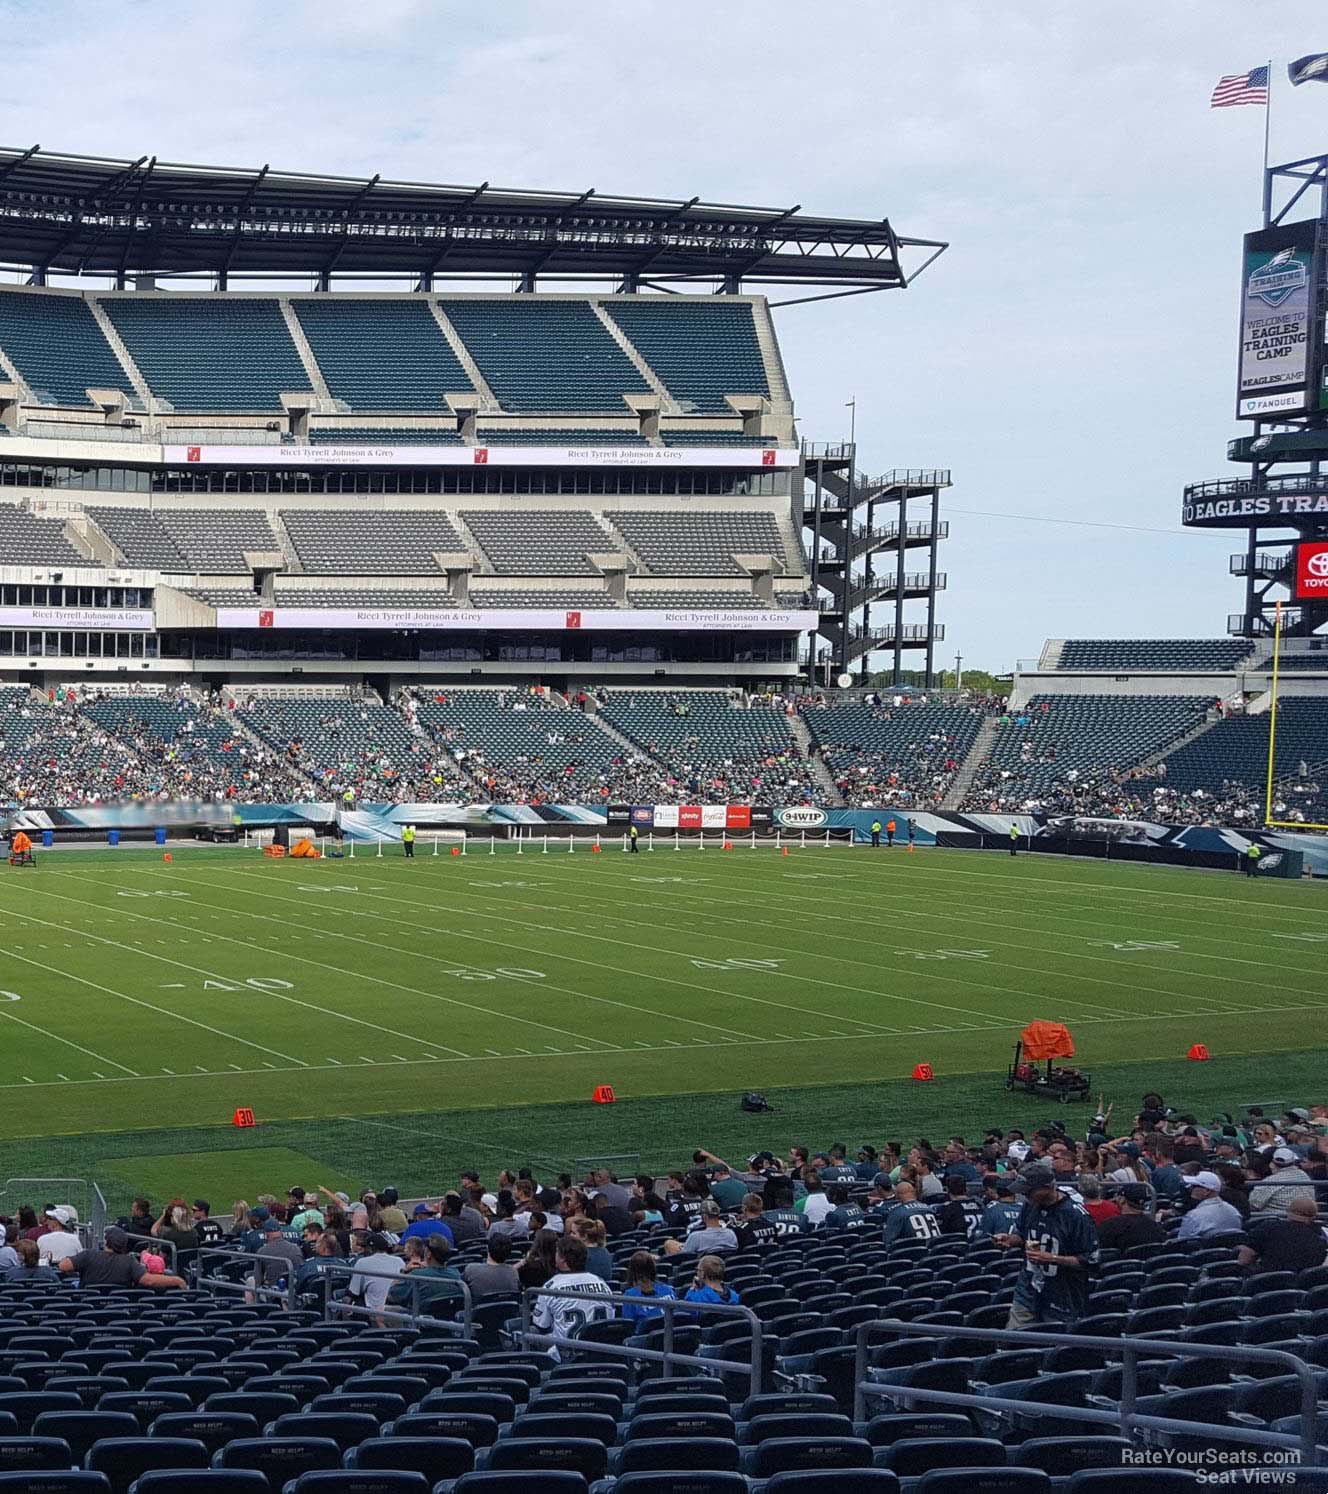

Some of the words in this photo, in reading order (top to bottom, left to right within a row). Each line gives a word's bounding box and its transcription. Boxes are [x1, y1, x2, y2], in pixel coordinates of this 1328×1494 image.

[1247, 315, 1292, 329] WELCOME
[1294, 311, 1305, 322] TO
[1252, 322, 1299, 339] EAGLES
[1244, 332, 1306, 351] TRAINING
[1256, 346, 1292, 360] CAMP
[1257, 397, 1296, 408] FANDUEL
[303, 449, 329, 458] Tyrrell
[331, 449, 366, 457] Johnson
[375, 449, 394, 458] Grey
[568, 450, 588, 458] Ricci
[591, 450, 617, 460] Tyrrell
[619, 450, 654, 458] Johnson
[663, 451, 683, 459] Grey
[1195, 498, 1270, 520] EAGLES
[1276, 495, 1328, 514] TRA
[32, 610, 53, 619] Ricci
[54, 611, 81, 621] Tyrrell
[83, 611, 116, 620] Johnson
[125, 613, 144, 622] Grey
[357, 612, 379, 620] Ricci
[382, 613, 411, 622] Tyrrell
[414, 613, 450, 621] Johnson
[461, 613, 482, 622] Grey
[665, 613, 688, 621] Ricci
[690, 613, 719, 623] Tyrrell
[721, 614, 759, 622] Johnson
[769, 614, 791, 623] Grey
[785, 812, 821, 821] 94WIP
[440, 967, 547, 982] 50
[202, 977, 294, 992] 40
[600, 1087, 613, 1101] 40
[238, 1110, 253, 1126] 30
[909, 1213, 941, 1239] 93
